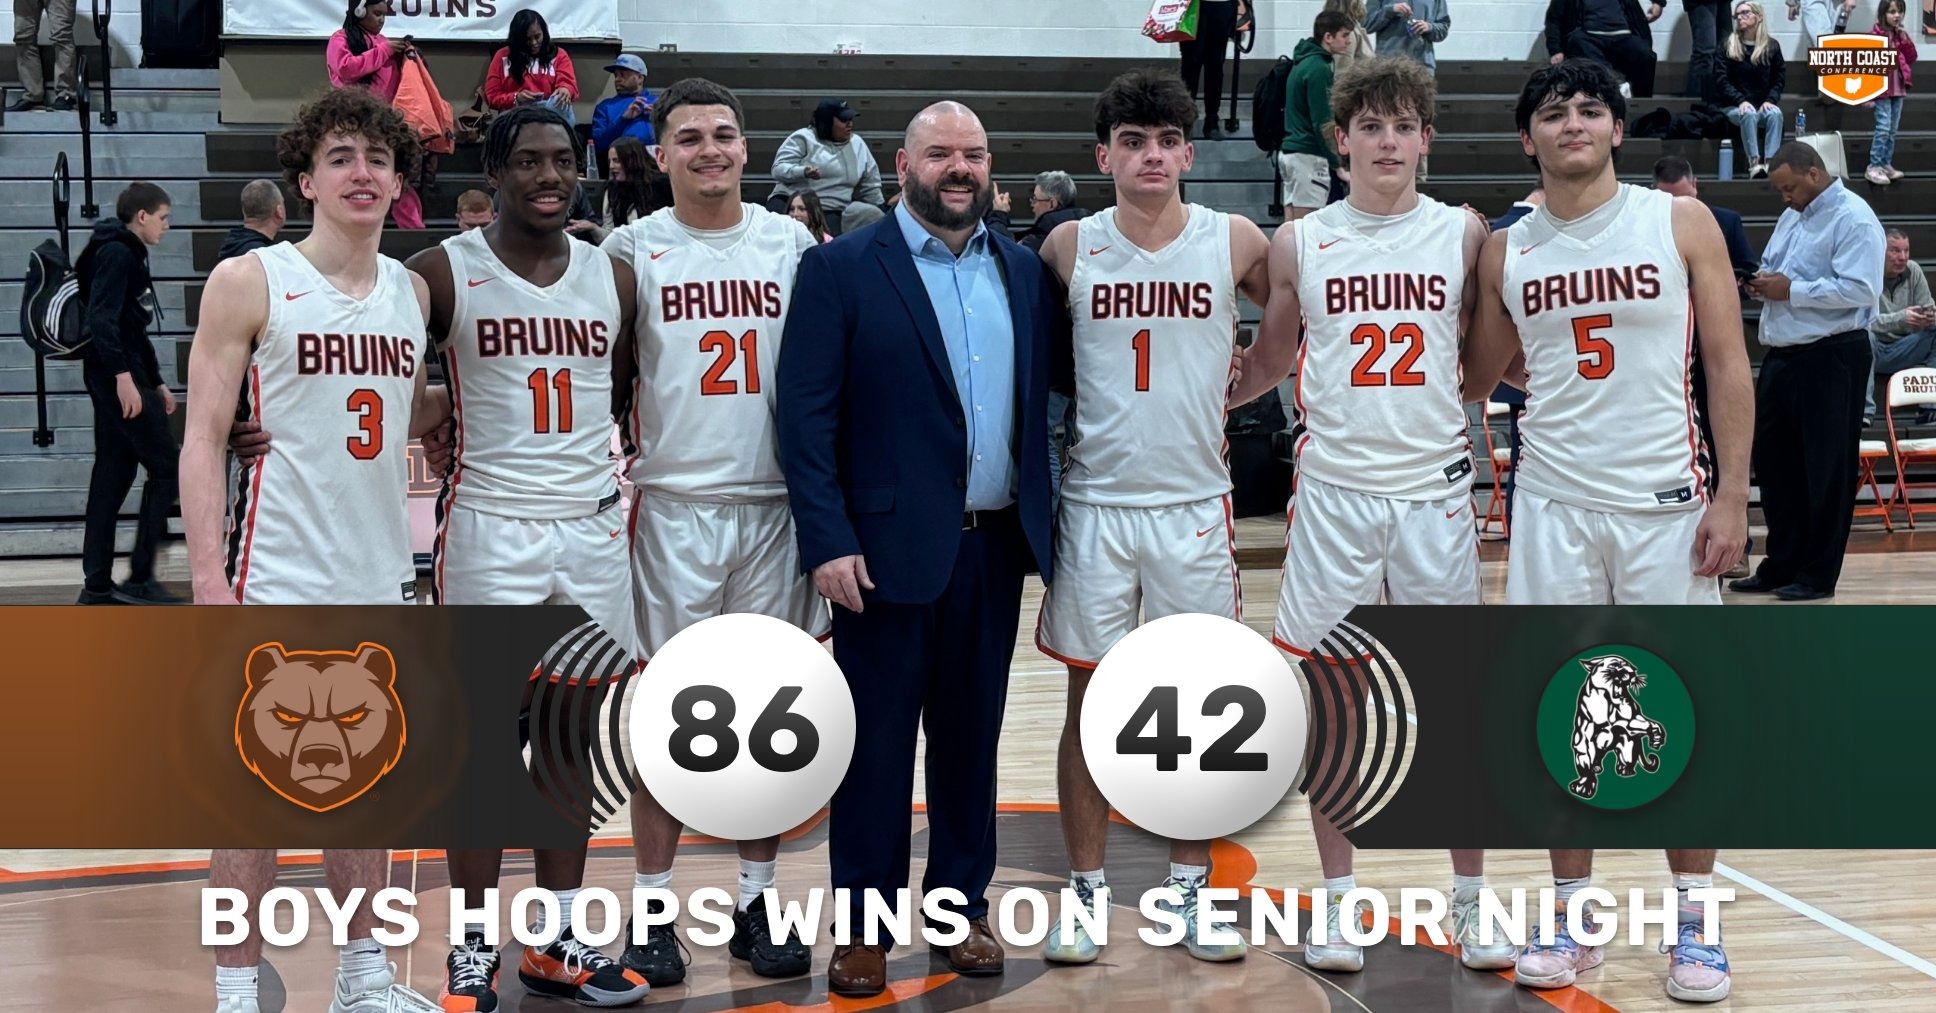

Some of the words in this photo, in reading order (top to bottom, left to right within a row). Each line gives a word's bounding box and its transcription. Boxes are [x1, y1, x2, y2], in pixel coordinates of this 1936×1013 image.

[661, 279, 782, 323] BRUINS
[1091, 281, 1212, 320] BRUINS
[1326, 273, 1447, 315] BRUINS
[1522, 264, 1661, 316] BRUINS
[297, 333, 415, 379] BRUINS
[476, 317, 609, 359] BRUINS
[698, 329, 761, 396] 21
[1131, 328, 1151, 392] 1
[1350, 322, 1426, 387] 22
[1570, 313, 1615, 381] 5
[346, 388, 384, 461] 3
[527, 367, 573, 434] 11
